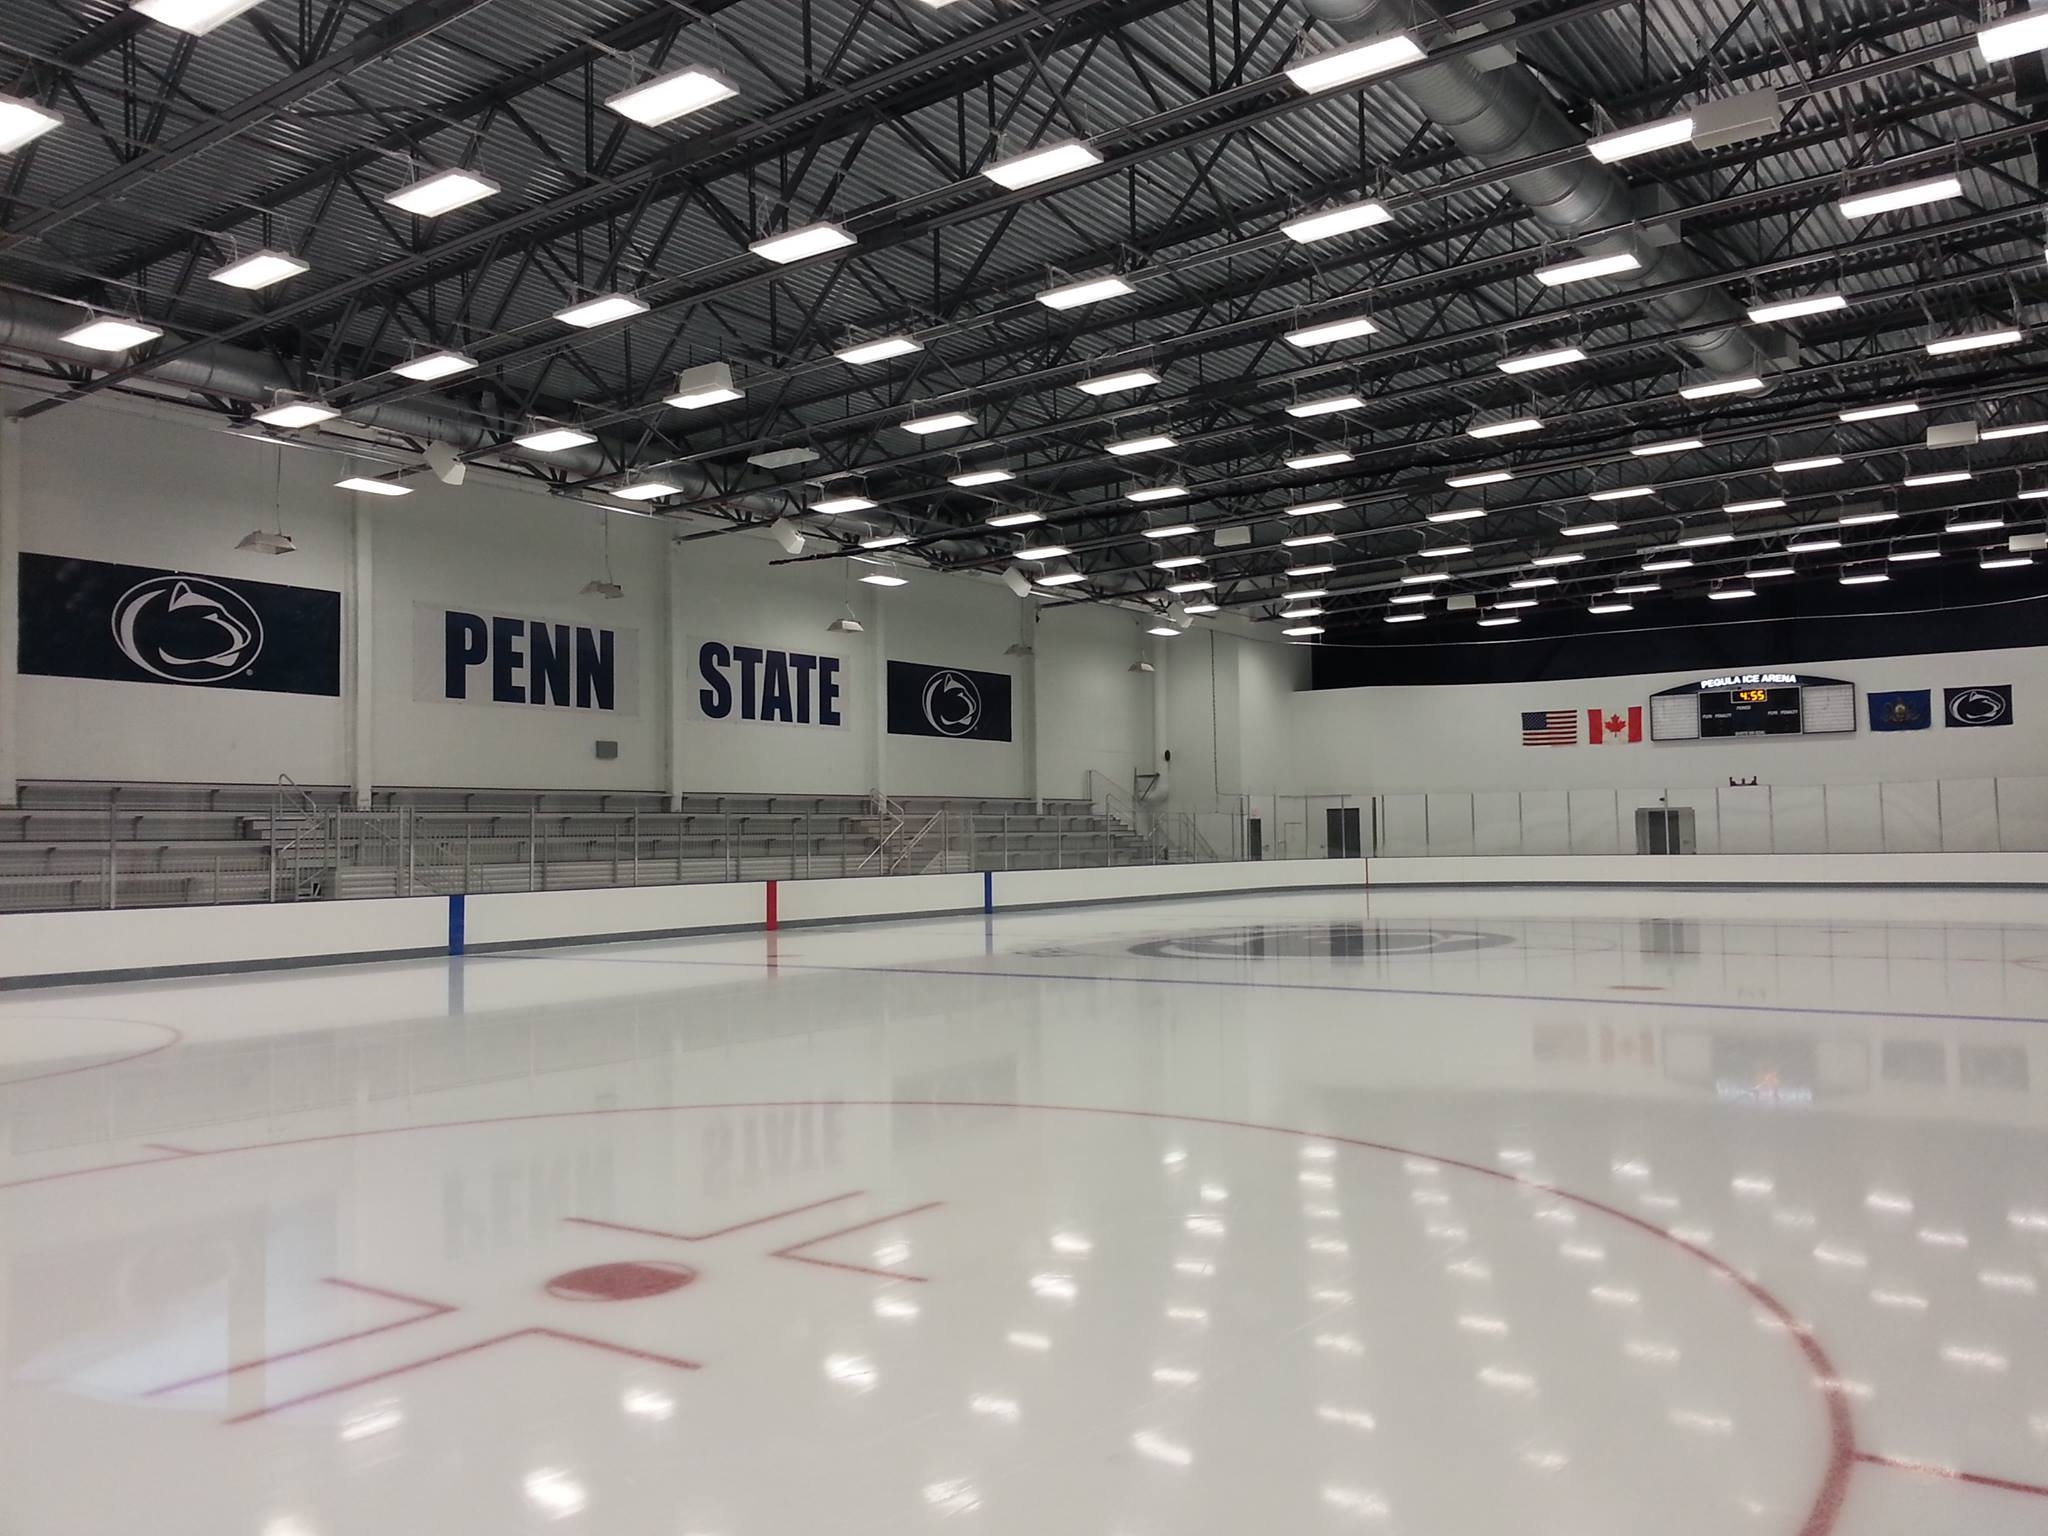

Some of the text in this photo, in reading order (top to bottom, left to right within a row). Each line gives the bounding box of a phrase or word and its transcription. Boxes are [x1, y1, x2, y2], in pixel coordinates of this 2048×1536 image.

[445, 610, 615, 710] PENN
[699, 641, 841, 726] STATE
[1700, 674, 1797, 689] PEGULA ICE ARENA
[1739, 690, 1765, 701] 4:55
